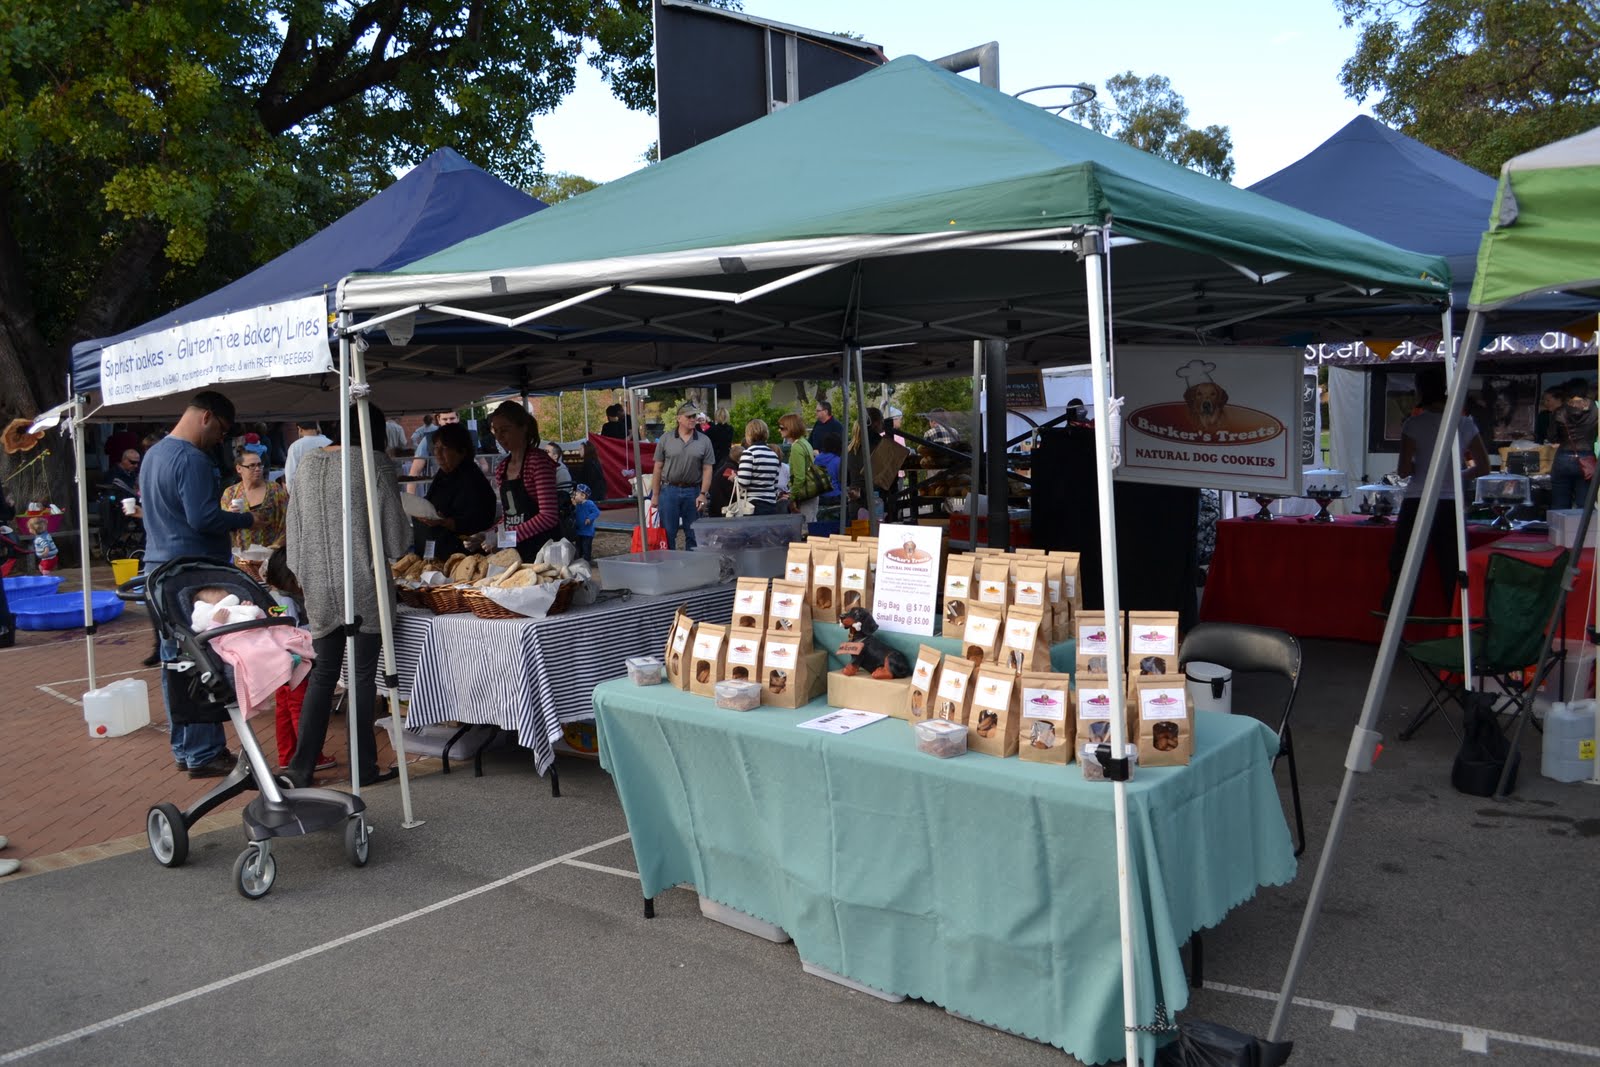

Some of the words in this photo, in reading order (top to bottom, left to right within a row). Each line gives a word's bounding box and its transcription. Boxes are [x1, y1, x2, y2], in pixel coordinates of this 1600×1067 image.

[177, 336, 212, 359] Gluten
[244, 322, 283, 348] Bakery
[287, 316, 319, 341] Lines
[1137, 416, 1212, 442] Barker's
[1215, 425, 1276, 442] Treats
[1135, 448, 1190, 462] NATURAL
[1193, 451, 1218, 463] DOG
[1221, 454, 1275, 467] COOKIES
[877, 600, 887, 609] Big
[888, 602, 900, 611] Bag
[906, 602, 912, 612] @
[876, 613, 892, 621] Small
[893, 614, 905, 625] Bag
[906, 616, 912, 625] @
[914, 616, 929, 626] $5.00
